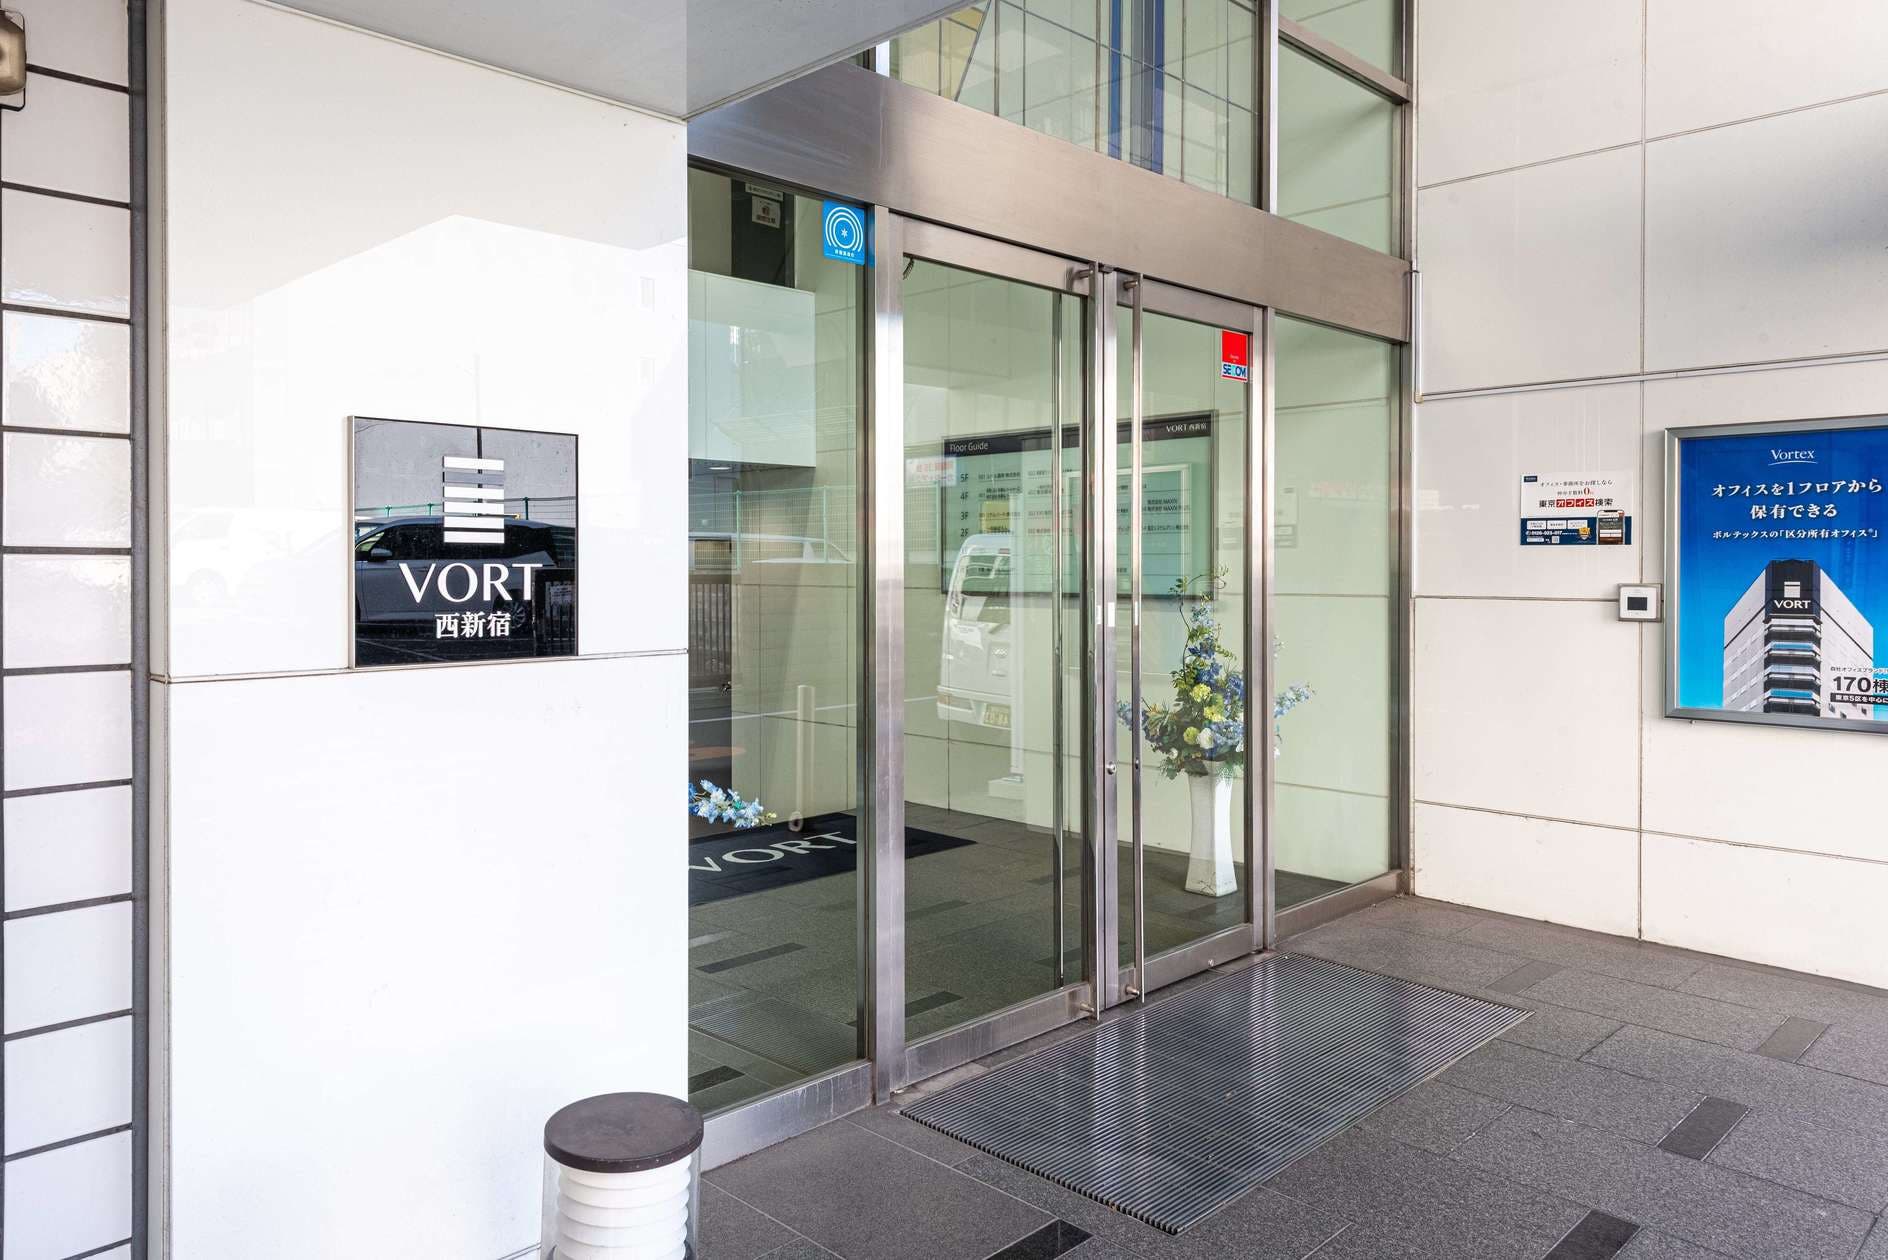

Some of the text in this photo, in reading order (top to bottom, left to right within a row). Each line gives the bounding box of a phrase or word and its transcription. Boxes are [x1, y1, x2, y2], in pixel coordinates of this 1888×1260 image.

[1223, 363, 1246, 377] SECOM
[1166, 423, 1187, 433] VORT
[968, 441, 989, 451] Guide
[1770, 449, 1815, 461] Vortex
[1711, 478, 1883, 498] オフィスを1フロアから
[1750, 503, 1838, 520] 保有できる
[398, 562, 543, 603] VORT
[1773, 600, 1812, 609] VORT
[434, 611, 512, 639] 西新宿
[688, 831, 857, 872] VORT
